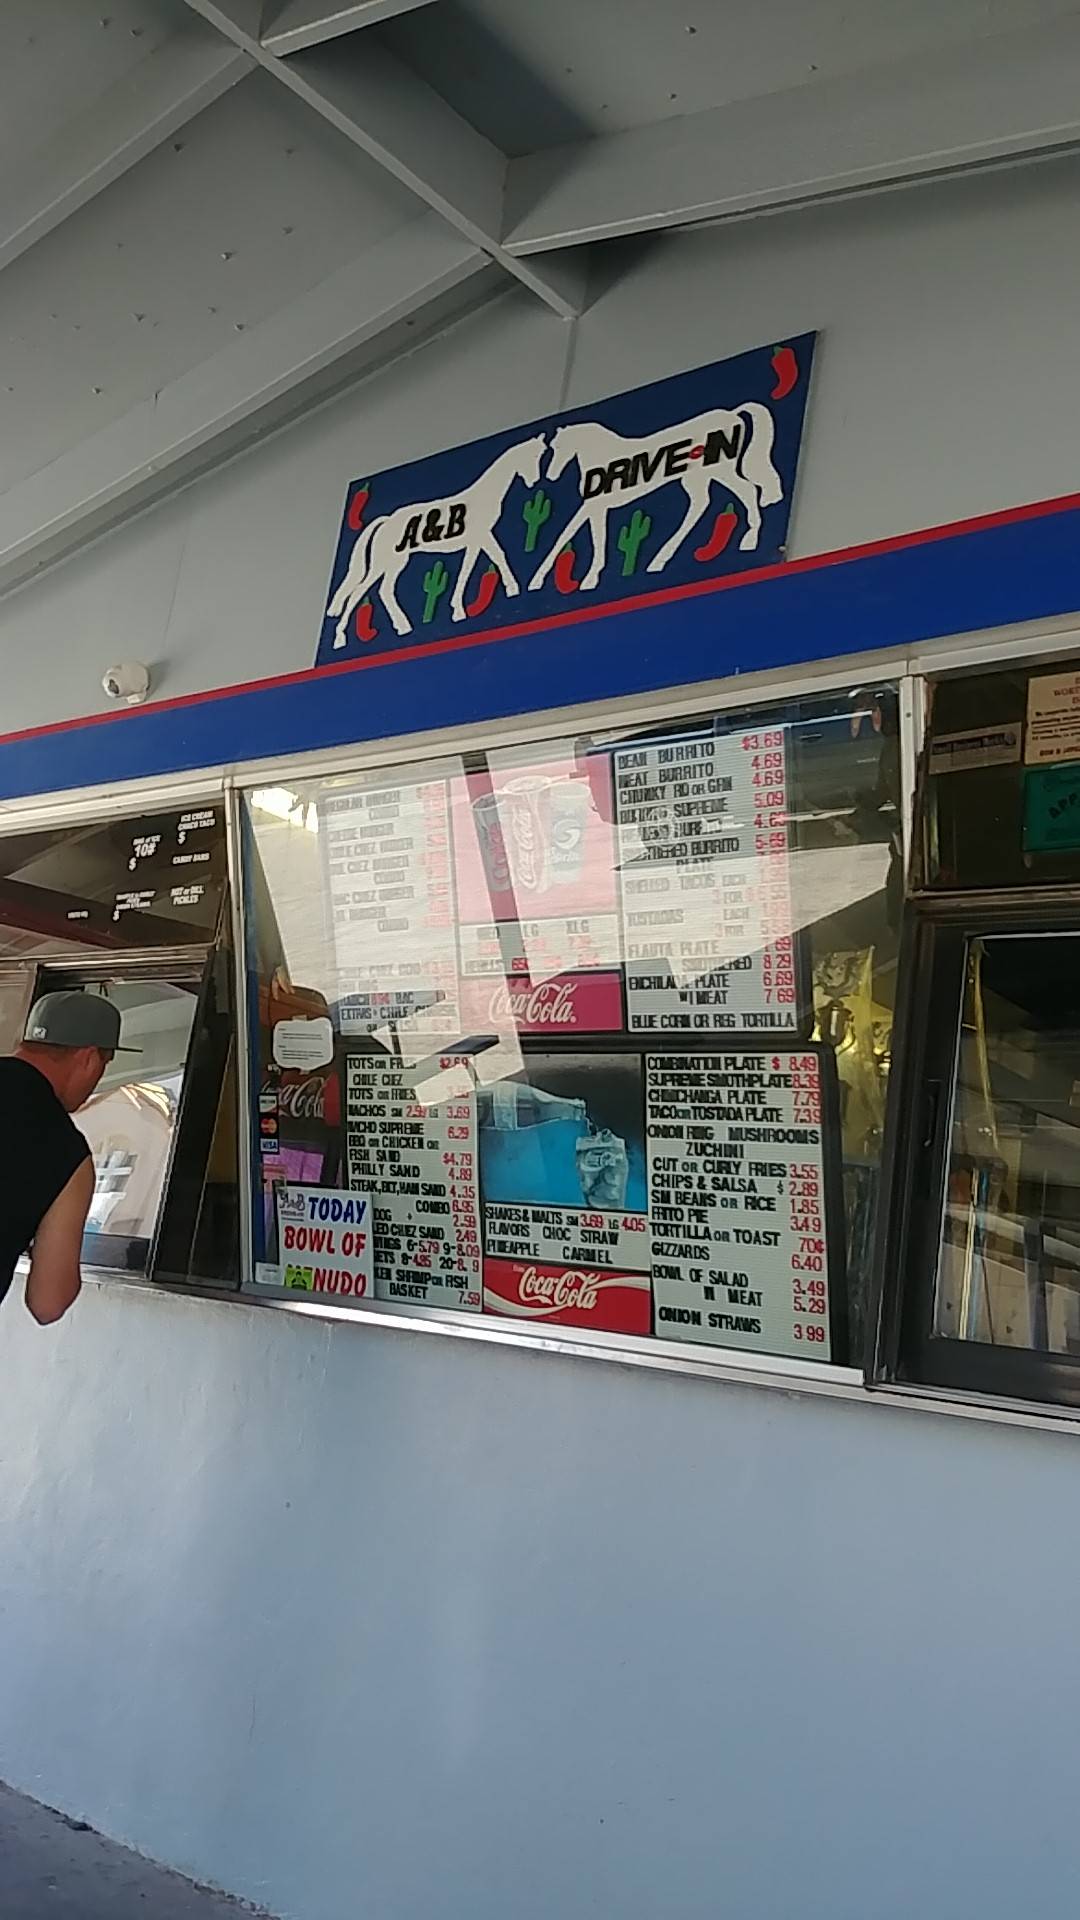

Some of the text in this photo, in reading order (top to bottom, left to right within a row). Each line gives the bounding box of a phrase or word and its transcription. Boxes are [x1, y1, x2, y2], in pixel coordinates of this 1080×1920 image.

[583, 425, 741, 500] DRIVE-IN
[395, 504, 466, 553] A&B
[658, 742, 715, 764] BURRITO
[742, 731, 784, 751] $3.69
[659, 762, 714, 783] BURRITO
[752, 752, 782, 770] 4.69
[620, 786, 665, 805] CHUNKY
[752, 769, 784, 787] 4.69
[754, 791, 784, 808] 5.09
[177, 831, 186, 844] $
[691, 837, 739, 856] BURRITO
[134, 843, 156, 857] 10#
[128, 857, 137, 871] $
[680, 940, 719, 956] PLATE
[695, 973, 730, 988] PLATE
[696, 990, 728, 1005] MEAT
[632, 1012, 795, 1028] BLUE CORN OR REG TORTILLA
[348, 1058, 373, 1069] TOTS
[648, 1056, 816, 1072] COMBINATION PLATE $ 8.49
[353, 1074, 378, 1086] CHILE
[648, 1073, 820, 1089] SUPREME PLATE 8.39
[348, 1088, 373, 1100] TOTS
[391, 1088, 416, 1100] FRIES
[728, 1091, 767, 1105] PLATE
[792, 1091, 821, 1106] 7.79
[348, 1105, 386, 1117] NACHOS
[447, 1106, 470, 1119] 3.69
[649, 1105, 677, 1119] TACO
[691, 1106, 744, 1121] TOSTADA
[746, 1108, 783, 1122] PLATE
[794, 1108, 822, 1124] 7.39
[348, 1121, 376, 1133] NACHO
[379, 1122, 424, 1135] SUPREME
[647, 1125, 819, 1144] ONION RING MUSHROOMS
[348, 1135, 365, 1147] BBQ
[382, 1136, 424, 1149] CHICKEN
[349, 1149, 472, 1166] FISH SAND $4.79
[351, 1163, 384, 1176] PHILLY
[390, 1165, 420, 1178] SAND
[653, 1157, 818, 1180] CUT OR CURLY FRIES 3.55
[421, 1183, 475, 1198] SAND 4.35
[652, 1173, 818, 1196] CHIPS & SALSA $ 2.89
[309, 1197, 367, 1224] TODAY
[415, 1200, 474, 1214] COMBO 6.95
[651, 1190, 819, 1215] SM BEANS OR RICE 1.85
[374, 1208, 392, 1221] DOG
[485, 1206, 646, 1232] SHAKES MALTS SM 3.69 LG 4.05
[688, 1209, 709, 1224] PIE
[790, 1216, 821, 1233] 3.49
[284, 1225, 367, 1258] BOWL OF
[391, 1224, 477, 1242] CHEZ SAND 2.49
[489, 1222, 619, 1245] FLAVORS CHOC STRAW
[650, 1222, 824, 1254] TORTILLA OR TOAST 70¢
[487, 1239, 613, 1264] PINEAPPLE CARMEL
[652, 1242, 822, 1272] GIZZARDS 6.40
[396, 1269, 431, 1285] SHRIMP
[445, 1275, 468, 1289] FISH
[519, 1266, 600, 1309] Coca-Cola
[653, 1264, 825, 1297] BOWL OF SALAD 3.49
[390, 1283, 428, 1299] BASKET
[727, 1288, 826, 1314] MEAT 5.29
[659, 1306, 761, 1334] ONION STRAWS
